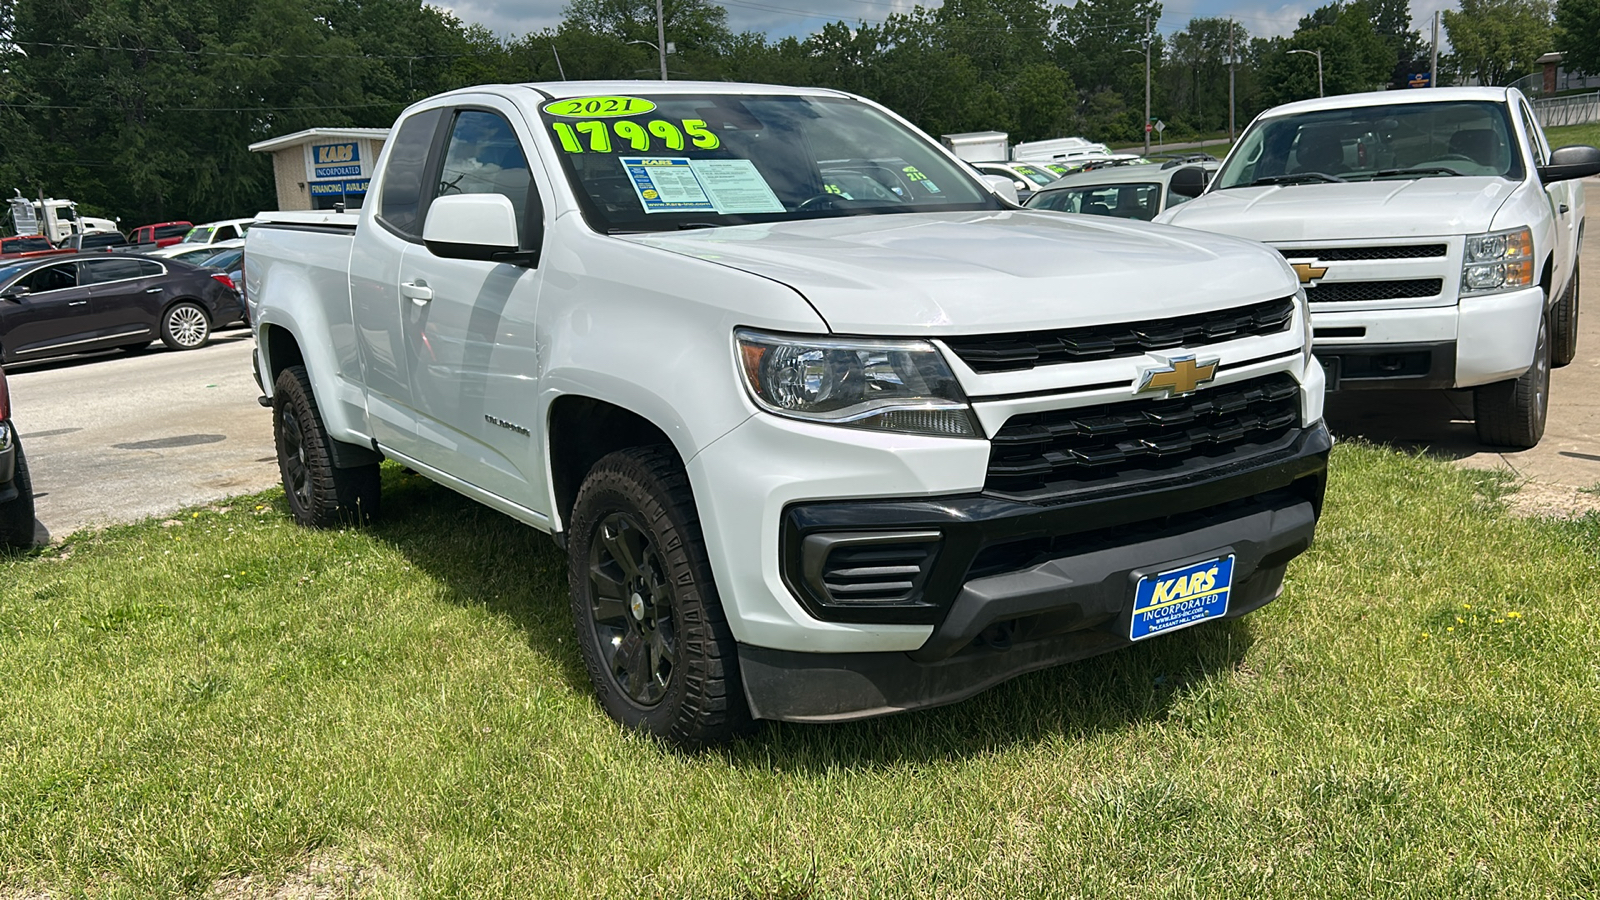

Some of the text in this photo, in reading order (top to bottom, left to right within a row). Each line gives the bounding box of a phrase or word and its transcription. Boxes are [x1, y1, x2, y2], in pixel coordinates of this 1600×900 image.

[567, 99, 634, 115] 2021
[553, 119, 720, 153] 17995
[319, 145, 353, 163] KARS
[316, 167, 360, 176] INCORPORATED
[312, 183, 342, 193] FINANCING
[1149, 566, 1219, 606] KARS
[1142, 594, 1219, 622] INCORPORATED
[1152, 619, 1179, 631] PLEASANT
